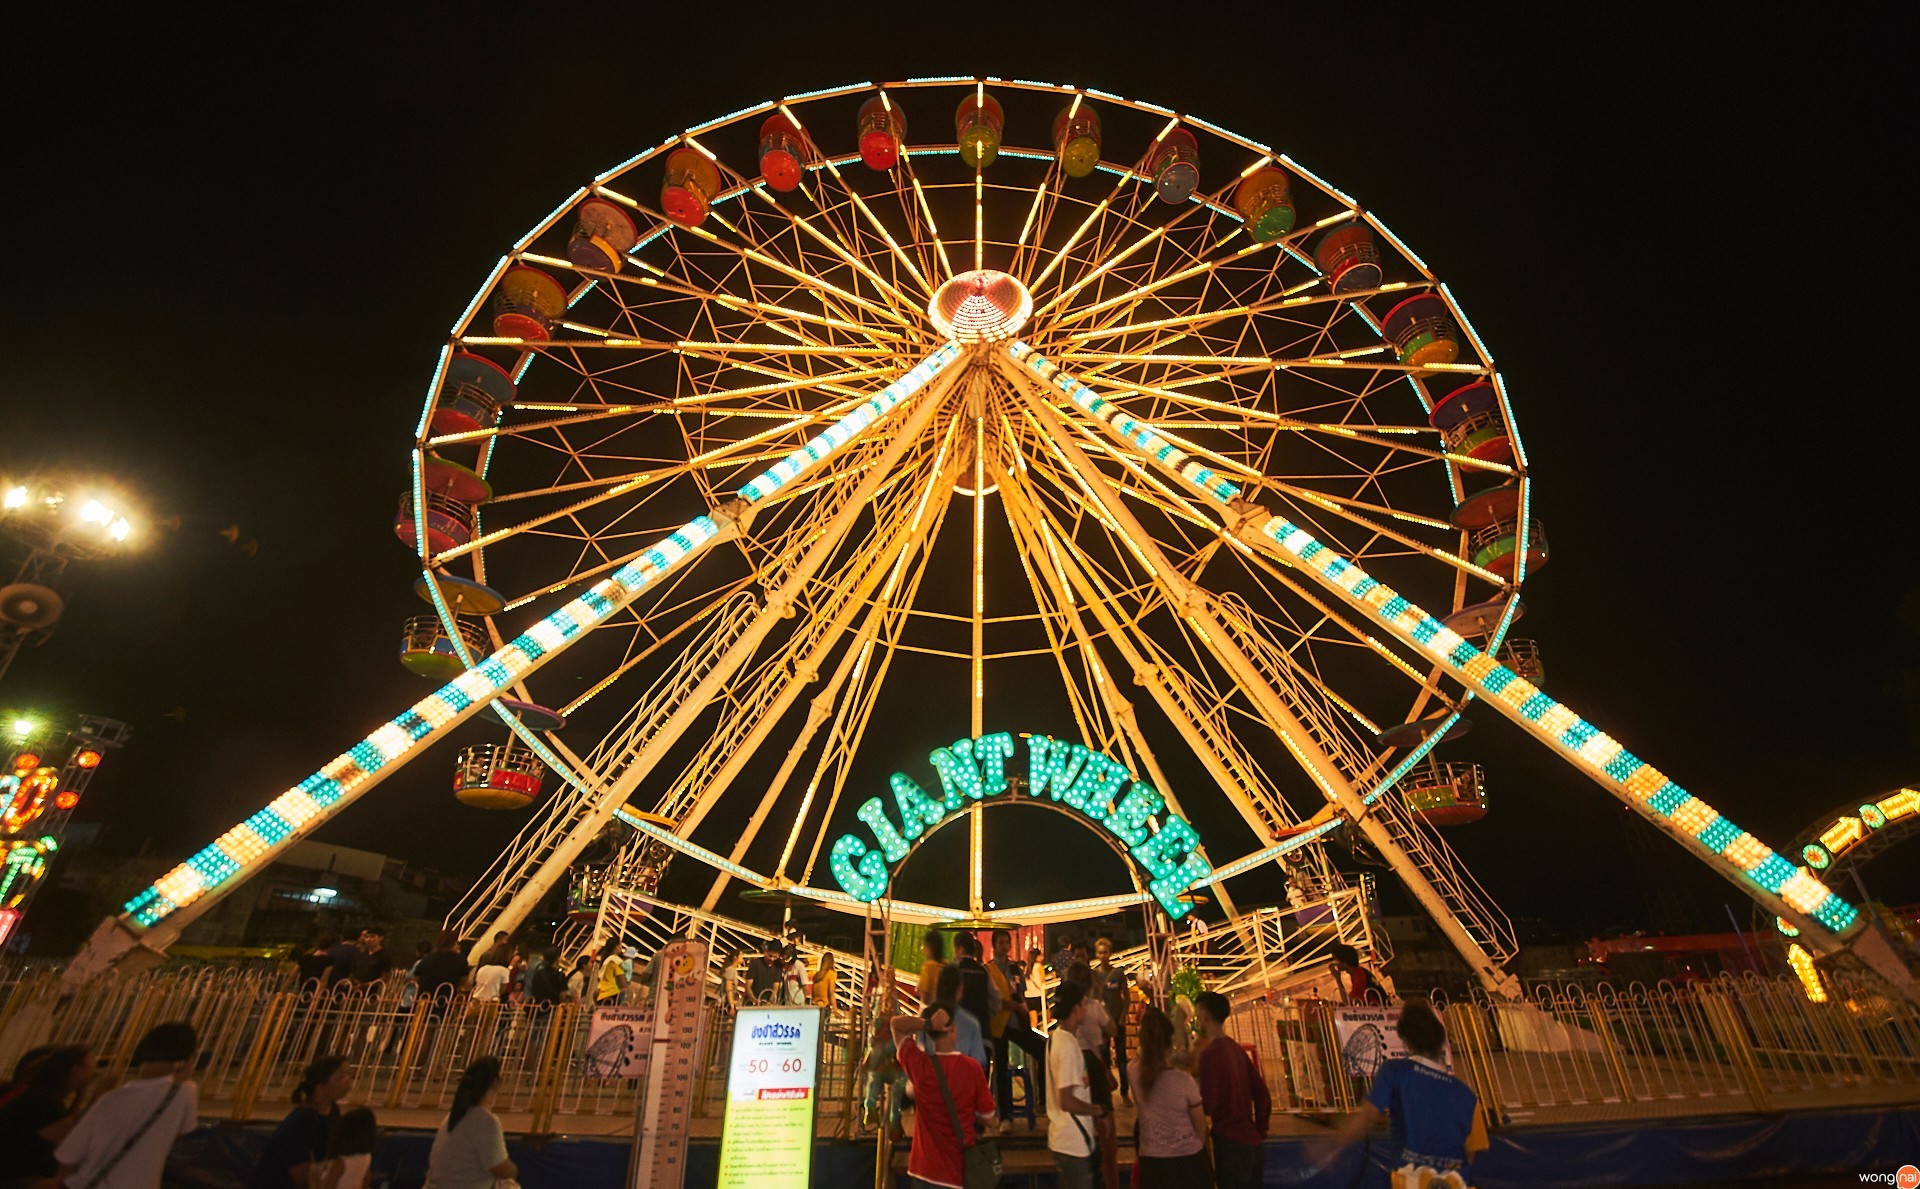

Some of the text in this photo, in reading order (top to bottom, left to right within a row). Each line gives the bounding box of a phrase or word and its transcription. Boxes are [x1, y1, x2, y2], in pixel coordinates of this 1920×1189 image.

[830, 732, 1212, 920] GIANT WHEEL
[748, 1059, 769, 1073] 50
[782, 1058, 802, 1072] 60
